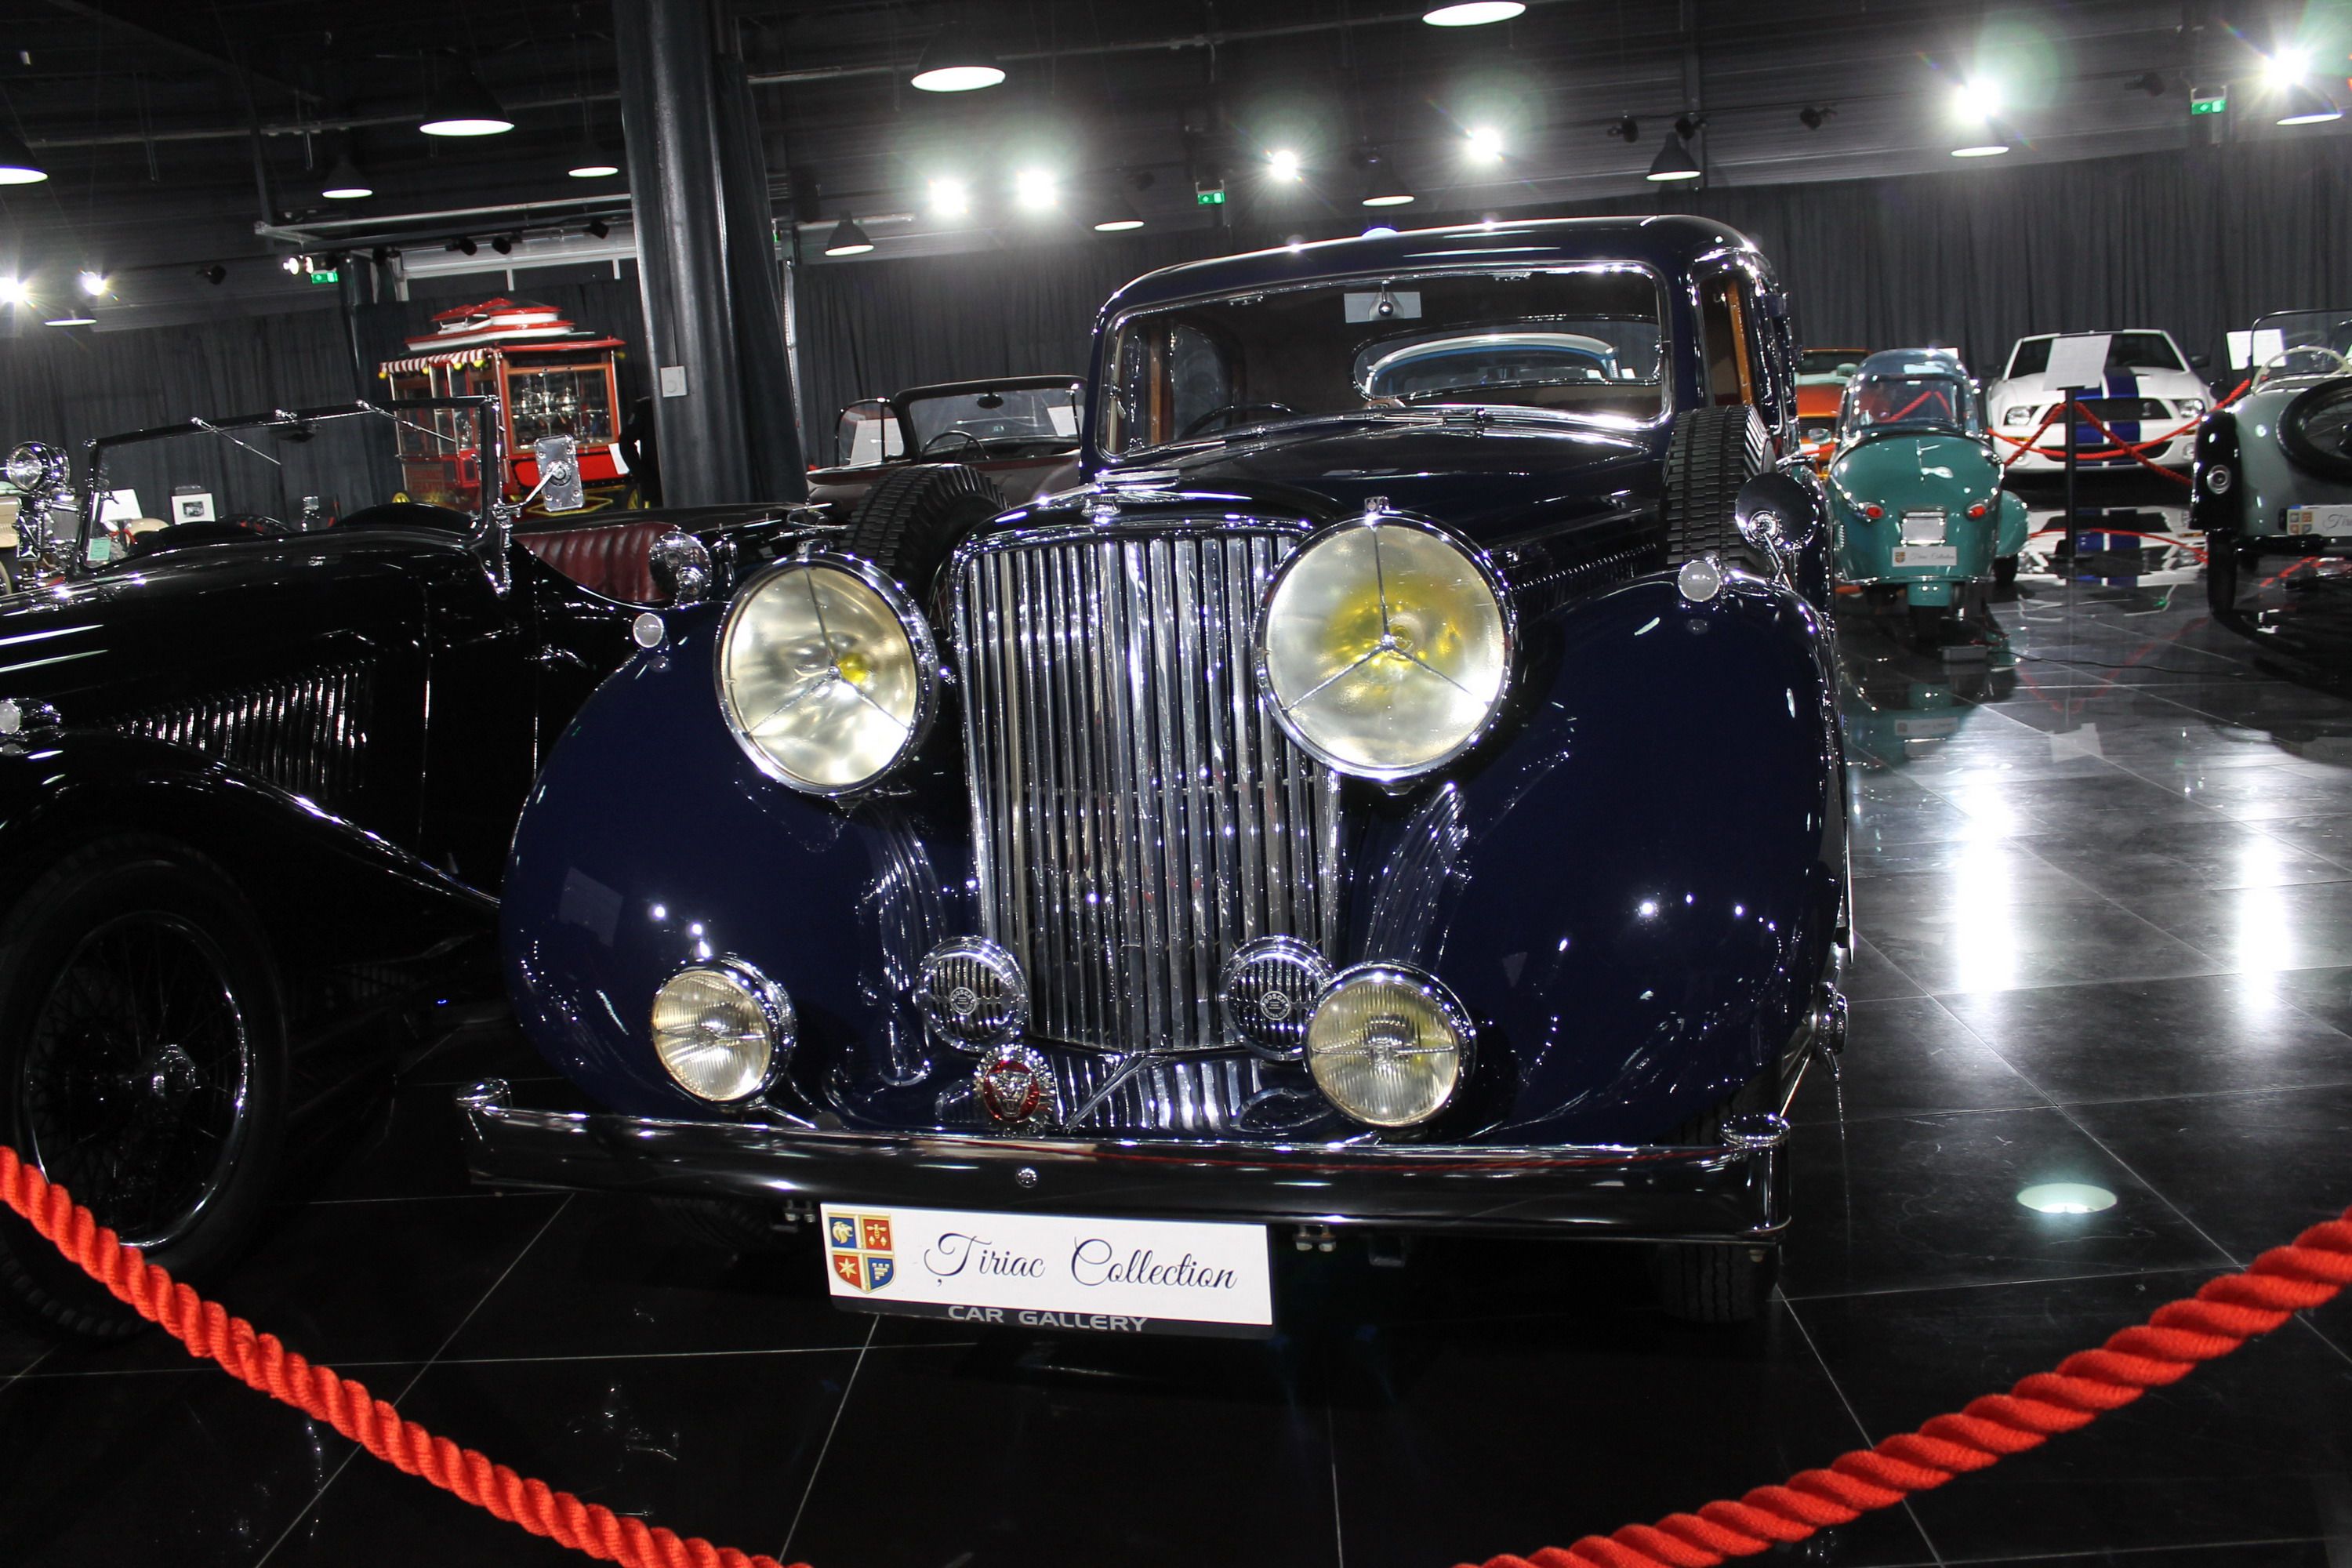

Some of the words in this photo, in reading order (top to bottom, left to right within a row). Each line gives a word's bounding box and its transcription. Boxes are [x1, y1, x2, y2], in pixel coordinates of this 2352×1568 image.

[1263, 993, 1287, 1004] BOSCH
[1071, 1236, 1238, 1290] Collection
[947, 1305, 1004, 1324] CAR
[1018, 1310, 1148, 1332] GALLERY
